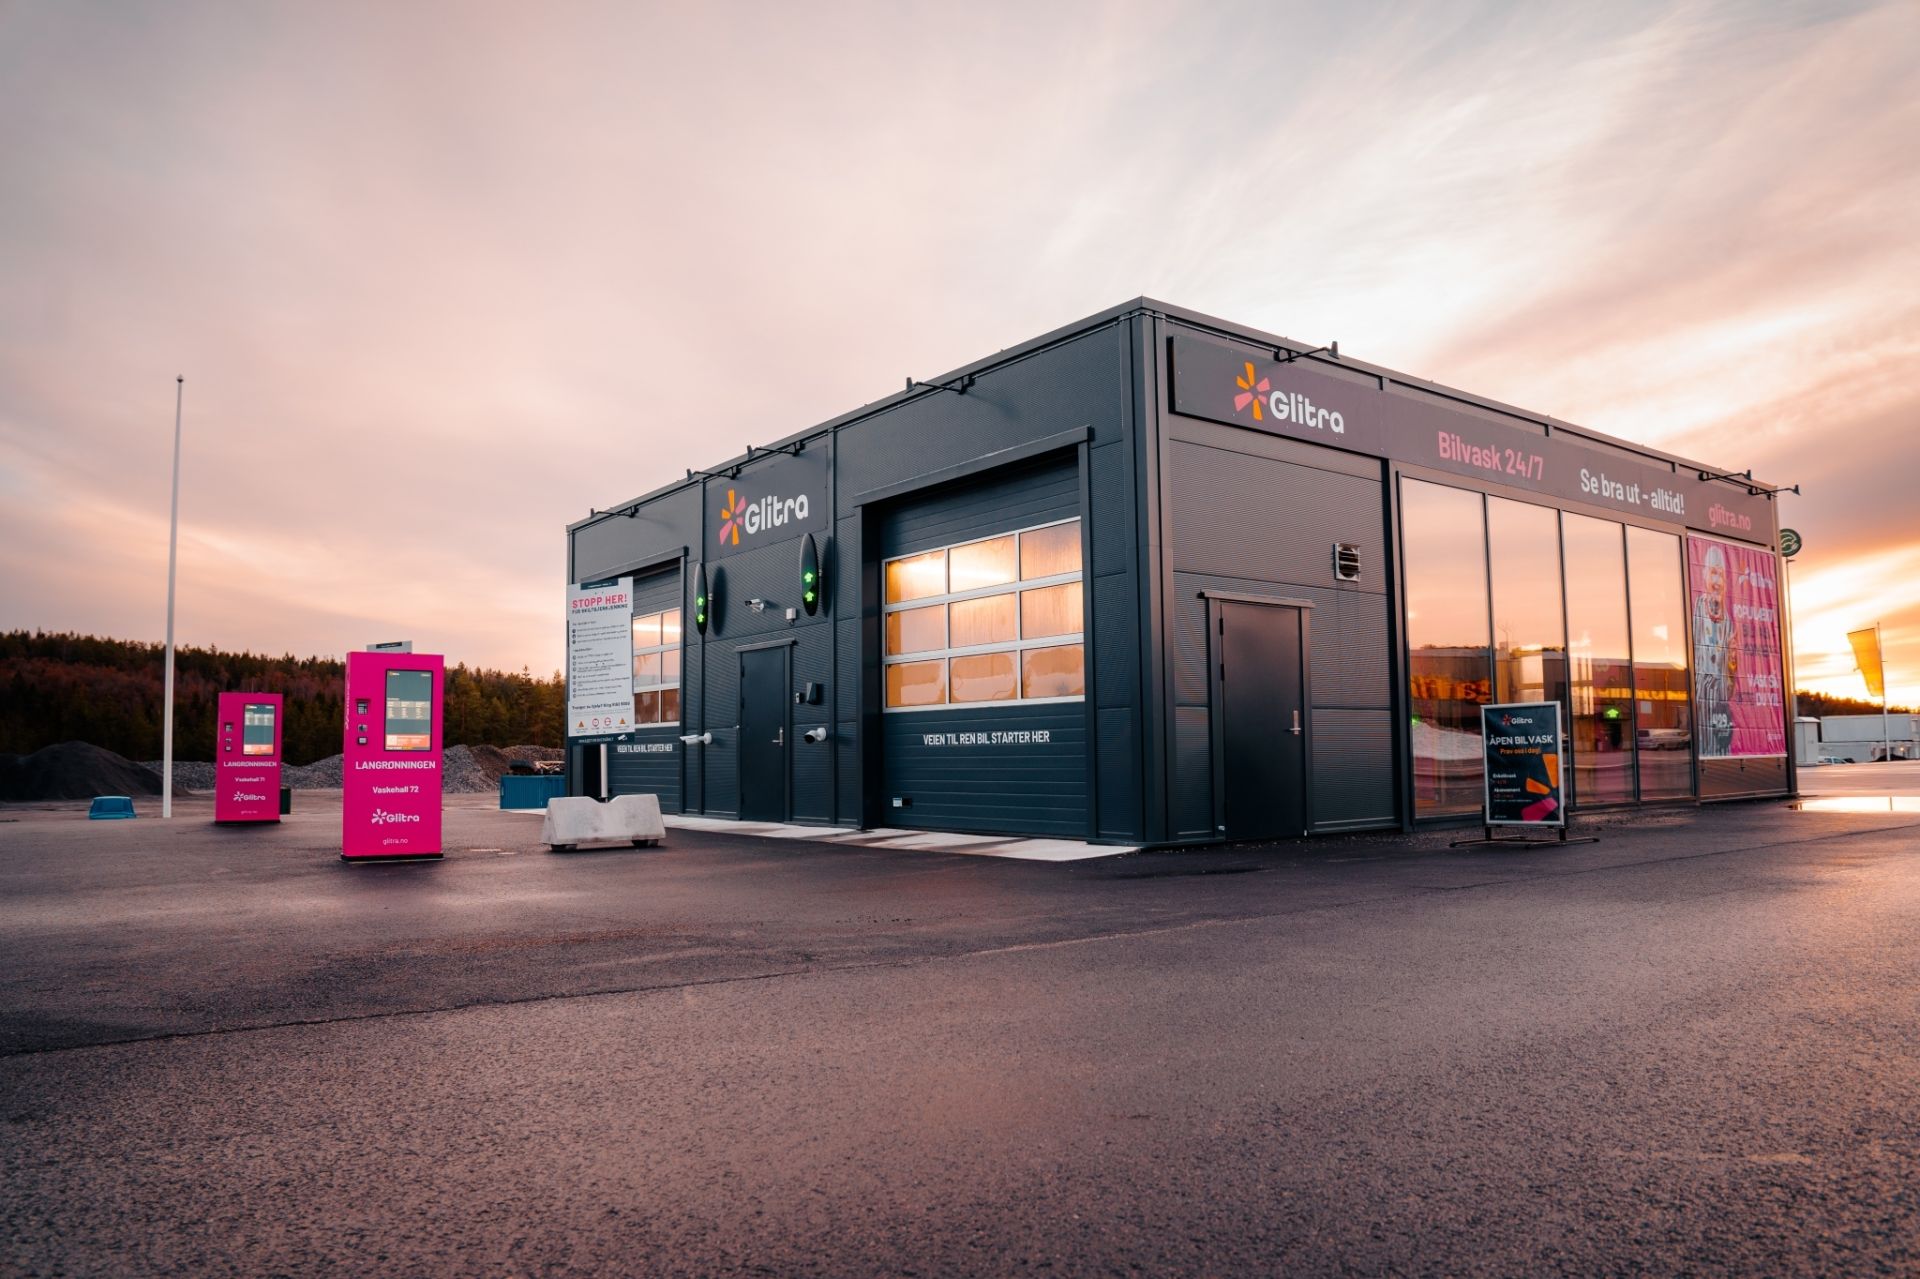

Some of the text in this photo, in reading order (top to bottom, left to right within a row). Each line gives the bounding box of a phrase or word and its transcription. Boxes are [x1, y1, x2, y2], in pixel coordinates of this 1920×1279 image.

[1269, 390, 1345, 434] Glitra
[1438, 430, 1544, 480] Bilvask 24/7
[1580, 468, 1599, 495] Se
[1601, 473, 1624, 501] bra
[1626, 483, 1641, 505] ut
[1650, 488, 1685, 515] alltid!
[744, 494, 809, 535] Glitra
[1708, 503, 1752, 532] glitra.no
[572, 593, 627, 609] STOPP HER!
[923, 731, 1050, 745] VEIEN TIL REN BIL STARTER HER
[1489, 734, 1553, 746] ÅPEN BILVASK
[355, 760, 436, 770] LANGRØNNINGEN
[372, 785, 419, 794] Vaskehall 72
[386, 813, 420, 823] Glitra
[382, 837, 409, 846] glitra.no
